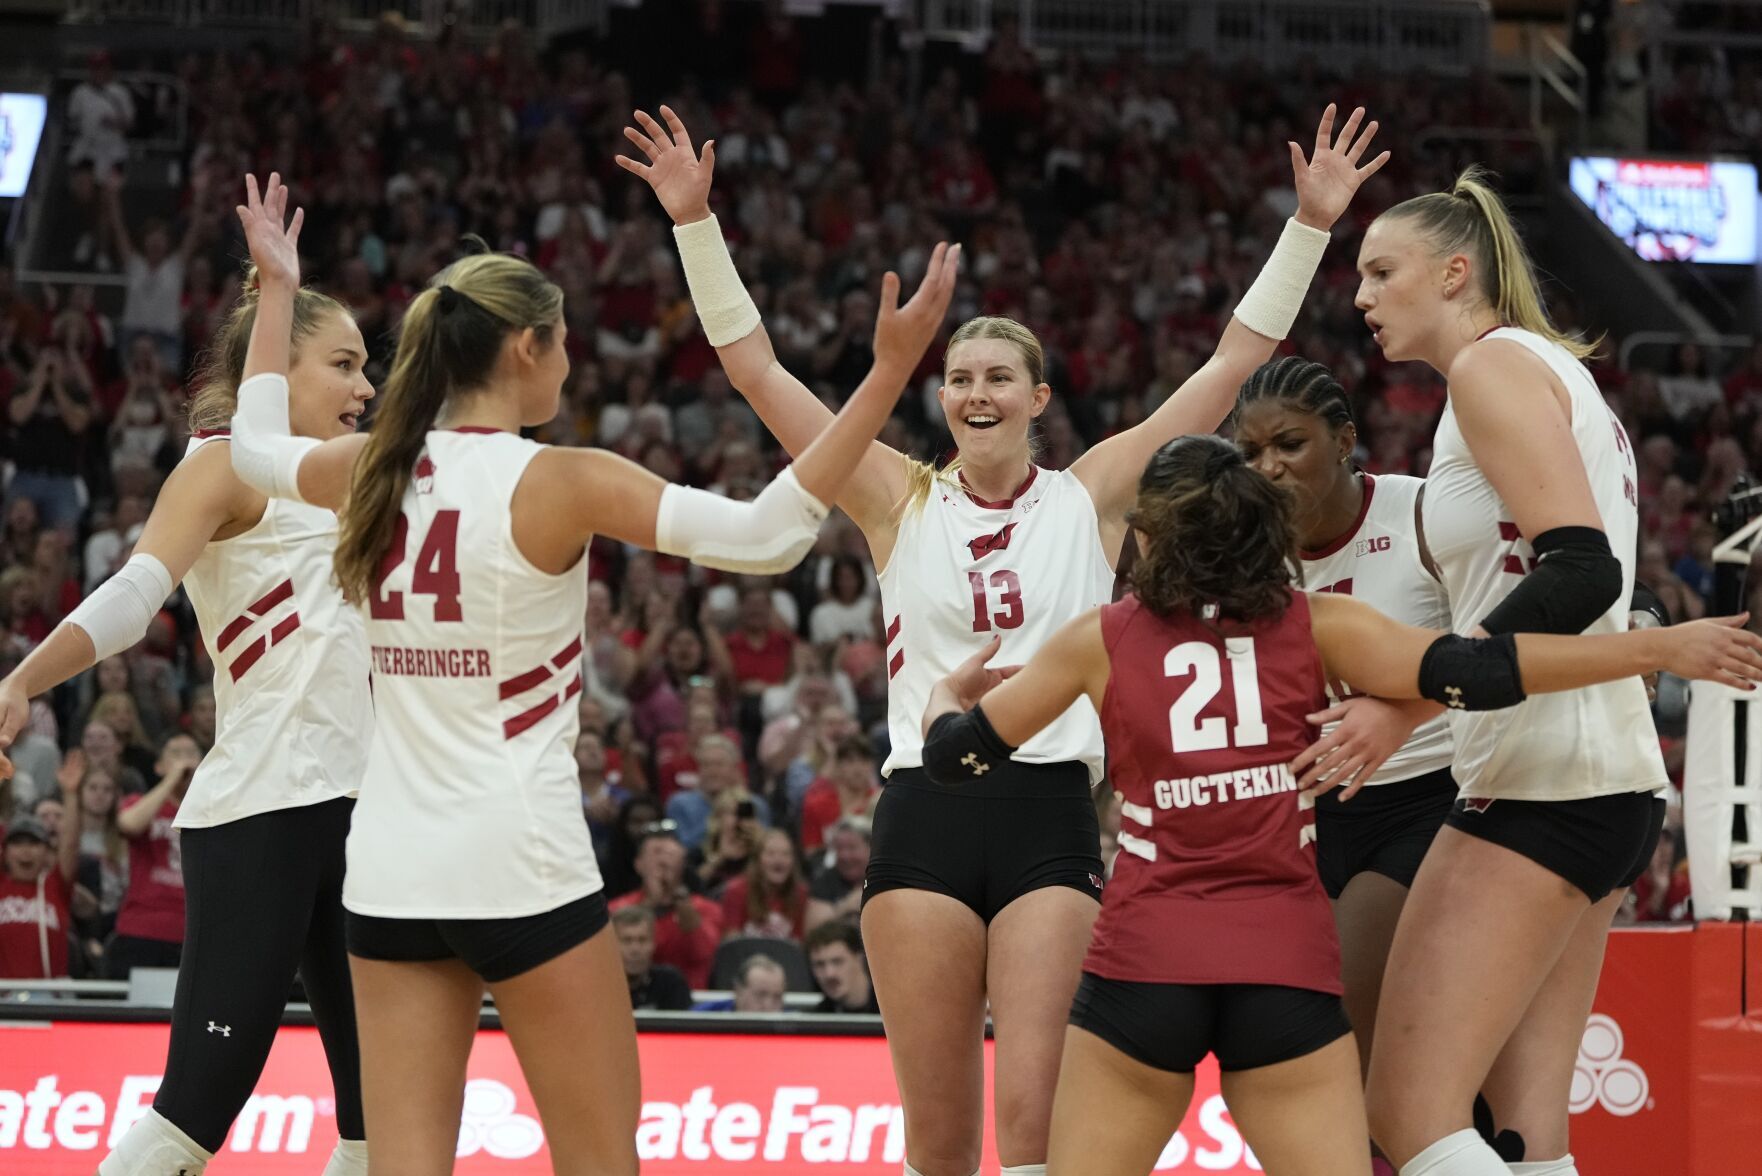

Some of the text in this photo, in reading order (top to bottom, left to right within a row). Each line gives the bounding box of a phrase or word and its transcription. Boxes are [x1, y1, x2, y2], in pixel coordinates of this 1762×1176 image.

[368, 509, 463, 622] 24
[968, 569, 1025, 632] 13
[1163, 636, 1269, 753] 21
[1153, 762, 1297, 810] GUCTEKIN
[763, 1087, 906, 1162] Far
